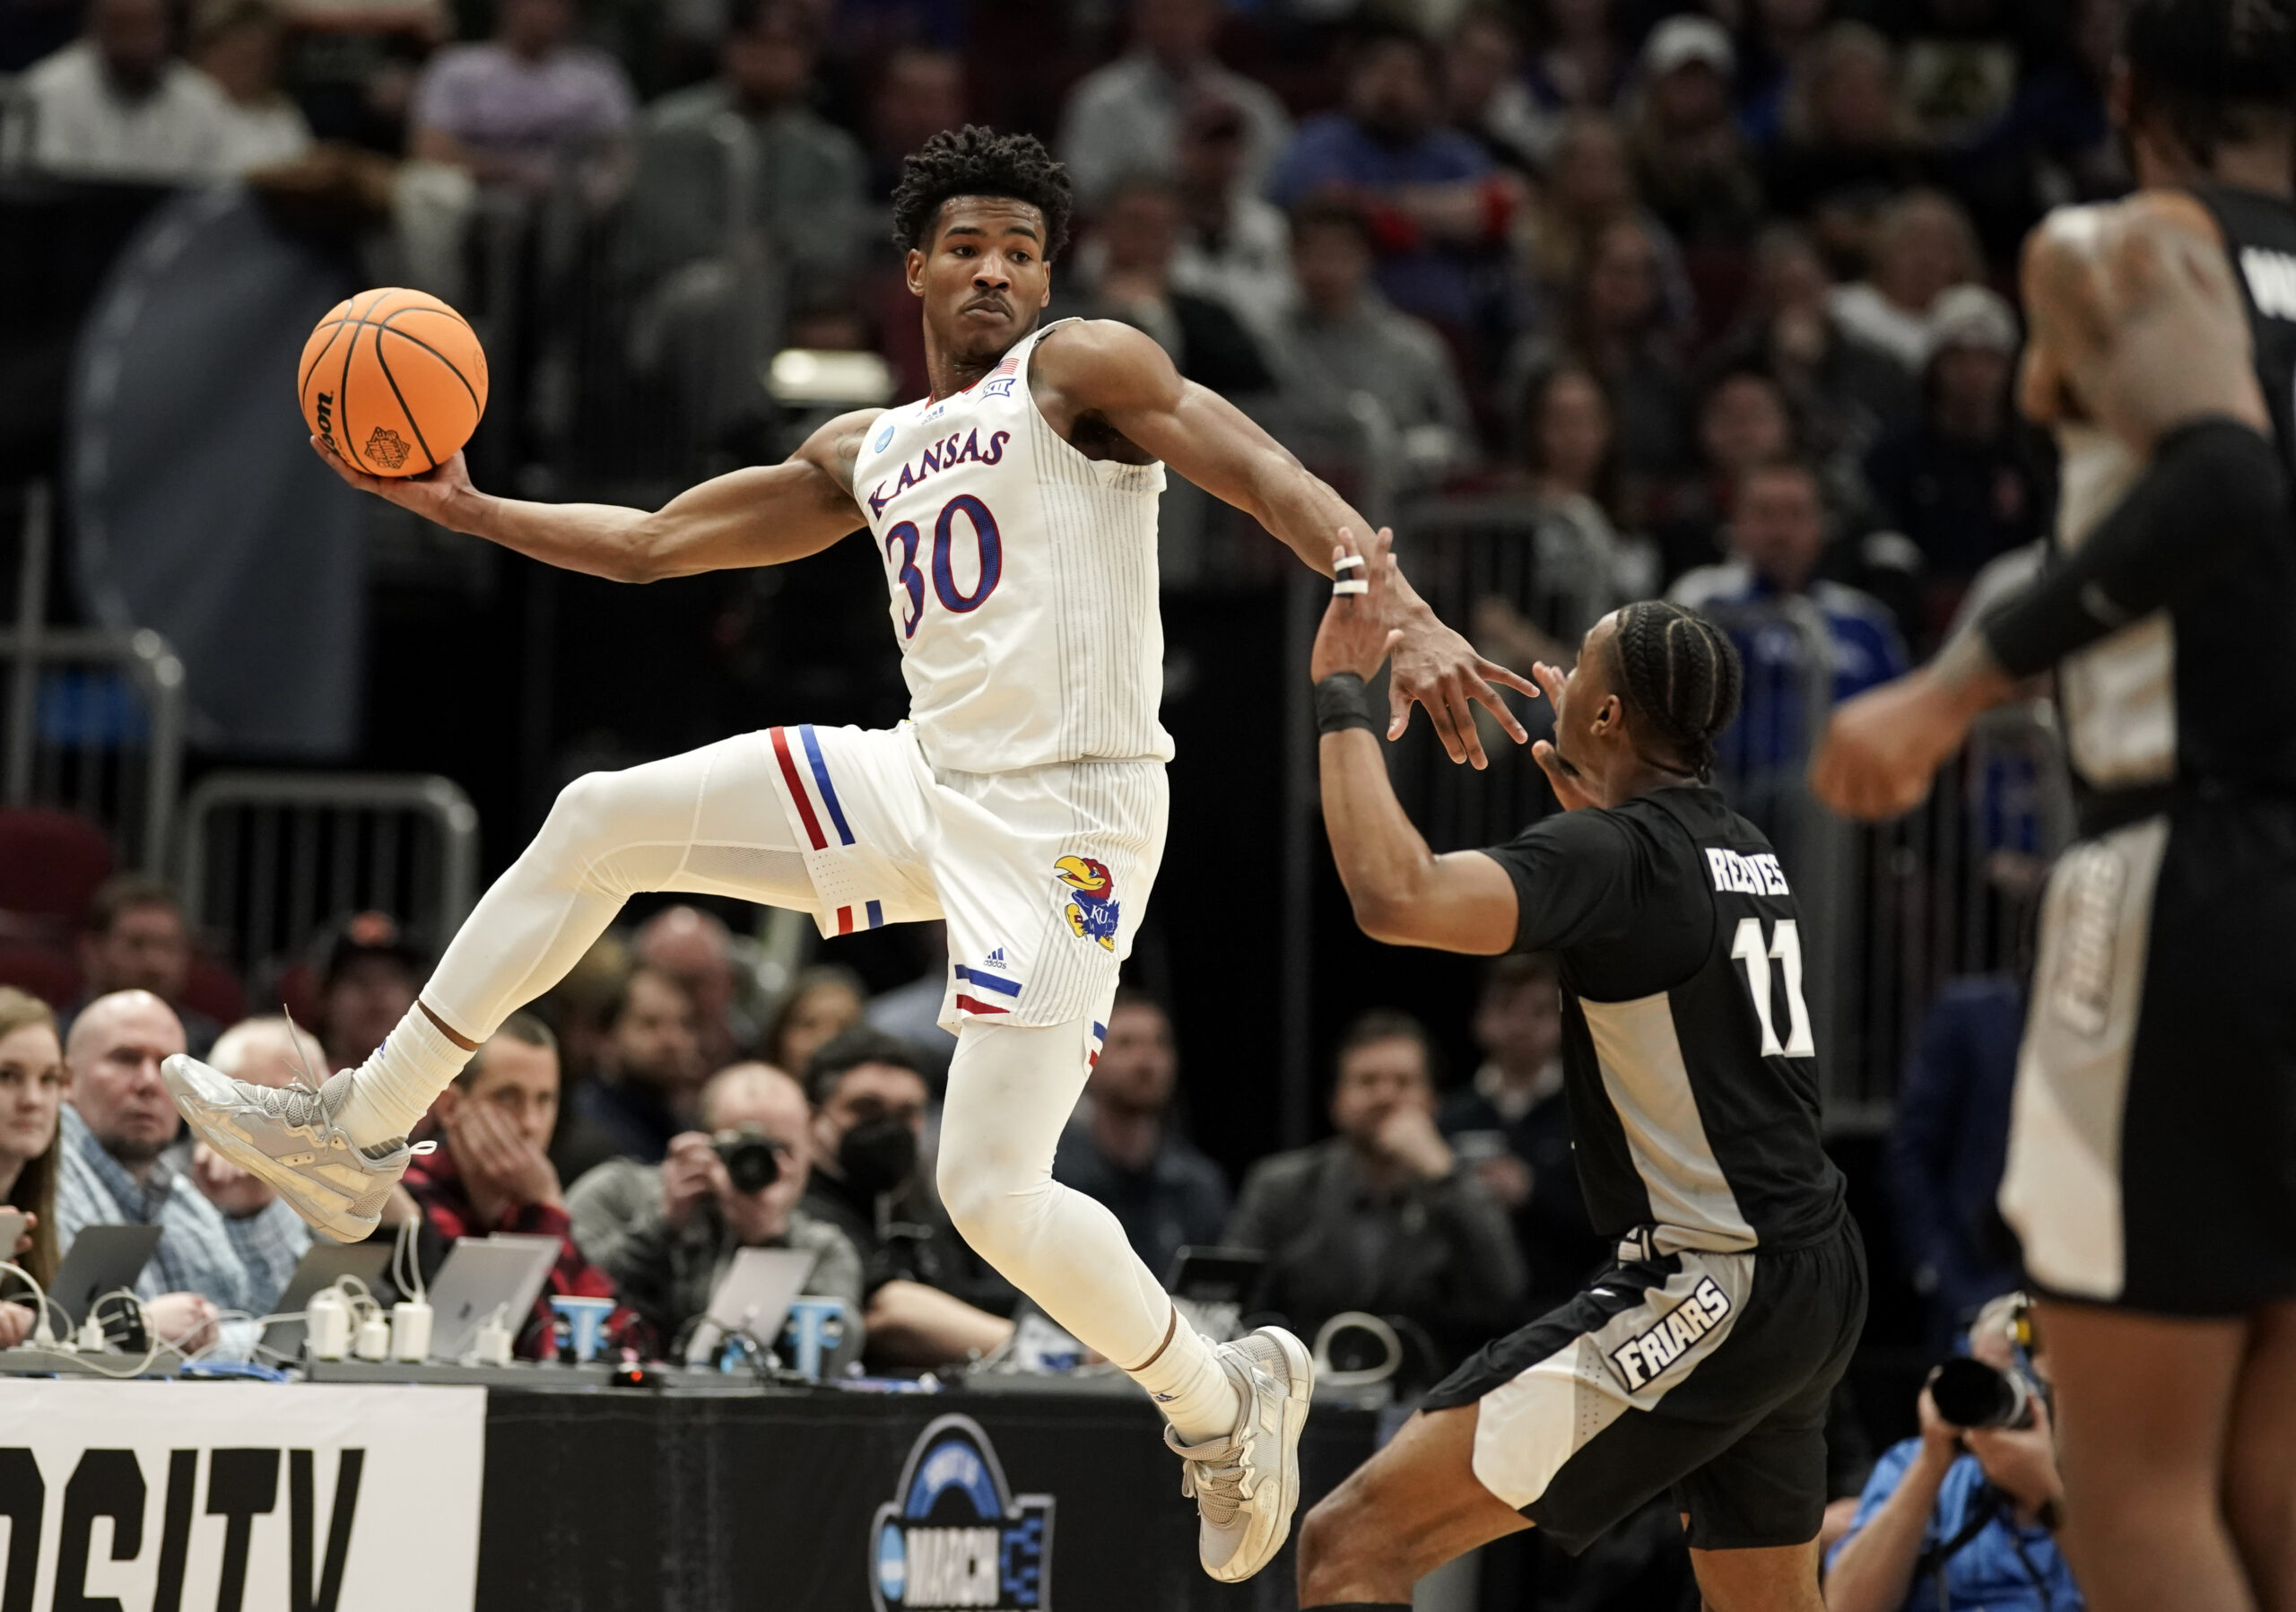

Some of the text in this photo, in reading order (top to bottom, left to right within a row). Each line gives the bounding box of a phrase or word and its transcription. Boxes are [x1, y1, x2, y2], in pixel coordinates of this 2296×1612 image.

[868, 427, 1011, 521] KANSAS
[885, 493, 1003, 640] 30
[983, 959, 1007, 970] adidas
[1090, 904, 1109, 925] KU
[1730, 917, 1815, 1059] 11
[1610, 1275, 1731, 1396] FRIARS
